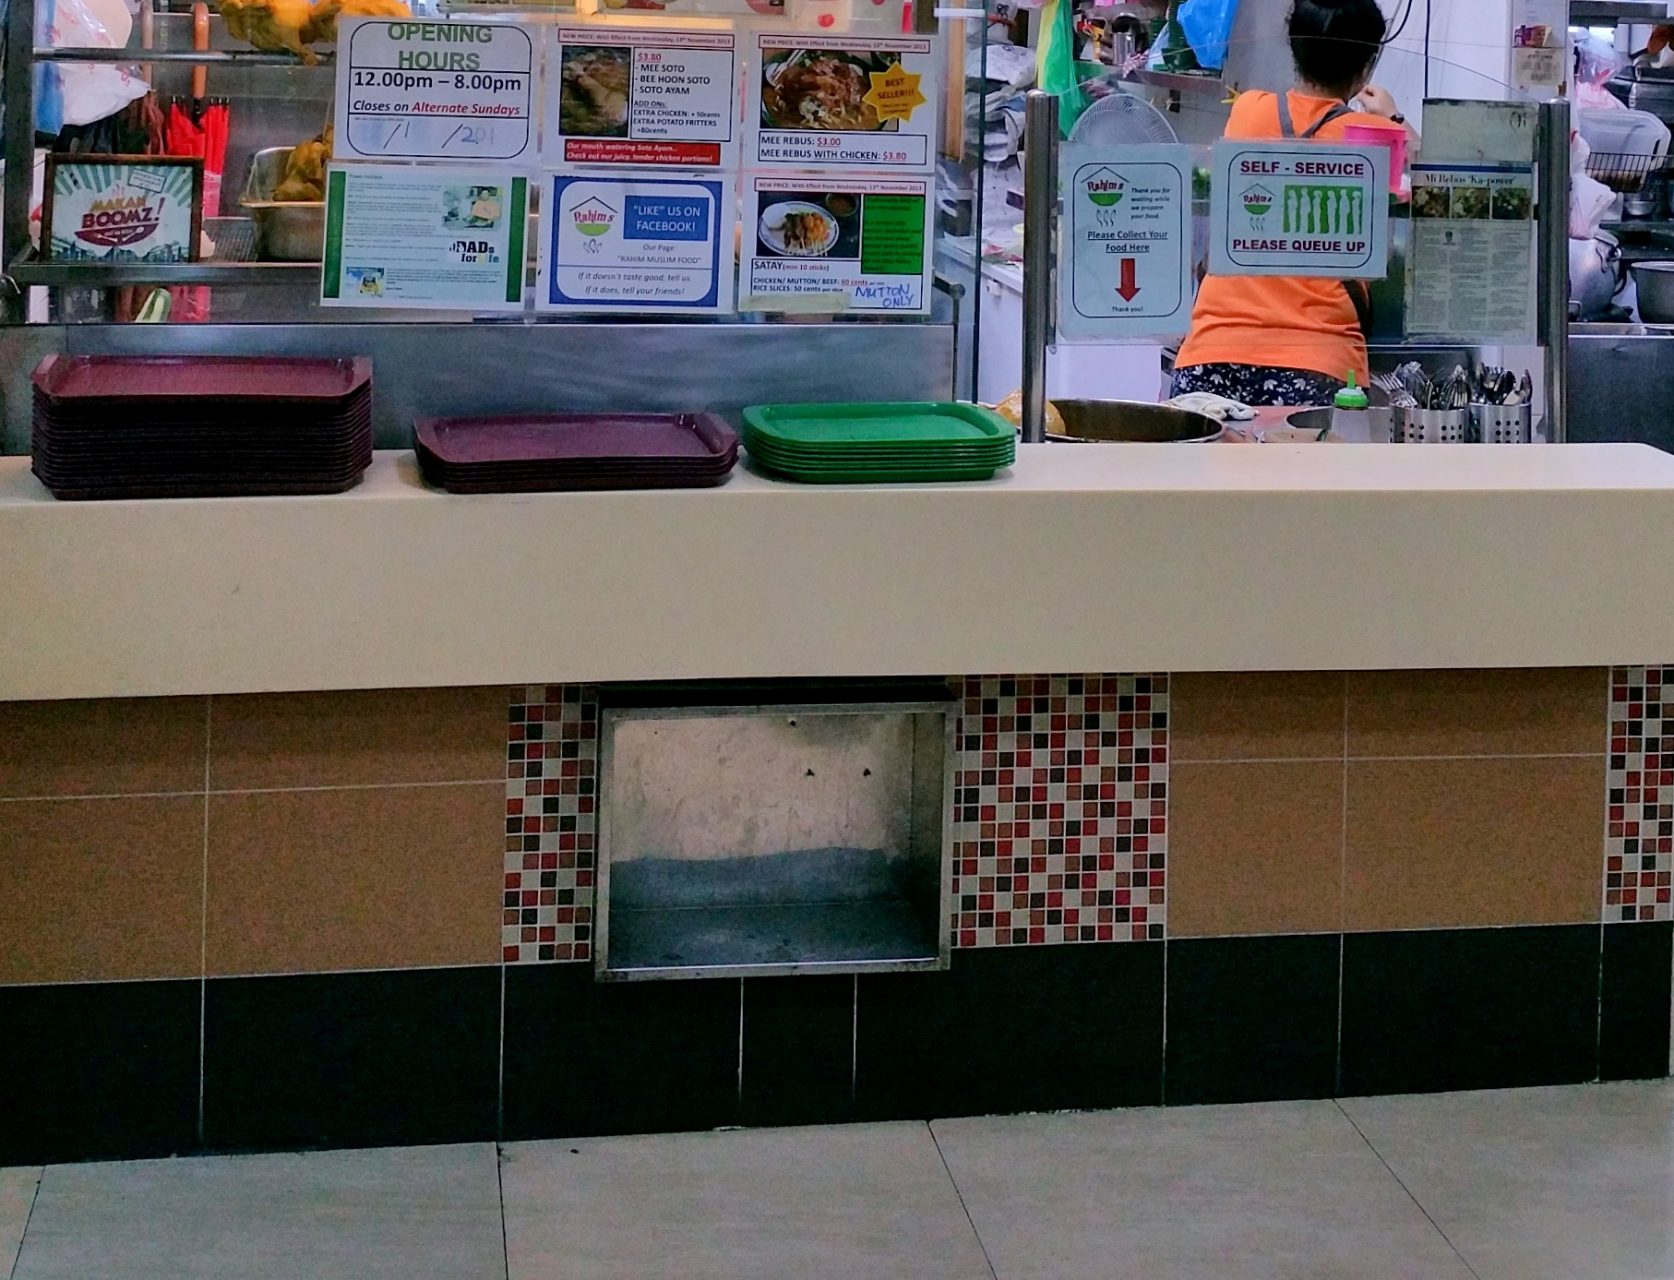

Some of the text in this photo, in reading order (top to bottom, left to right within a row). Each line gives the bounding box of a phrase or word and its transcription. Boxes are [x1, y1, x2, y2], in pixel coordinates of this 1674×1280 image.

[387, 23, 493, 44] OPENING
[399, 50, 481, 71] HOURS
[640, 64, 685, 73] MEE SOTO
[354, 71, 433, 91] 12.00pm
[454, 74, 521, 94] 8.00pm
[640, 75, 656, 83] BEE
[658, 76, 685, 84] HOON
[885, 77, 905, 88] BEST
[639, 86, 690, 95] SOTO AYAM
[353, 100, 520, 116] Closes on Alternate Sundays
[633, 109, 656, 117] EXTRA
[761, 136, 841, 147] MEE REBUS: $3.00
[760, 149, 780, 158] MEE
[782, 149, 812, 158] REBUS
[813, 150, 838, 159] WITH
[1240, 161, 1280, 173] SELF
[1295, 161, 1364, 175] SERVICE
[90, 195, 146, 211] MAKAN
[82, 197, 166, 228] BOOMZ!
[667, 206, 682, 217] US
[684, 207, 701, 217] ON
[1087, 230, 1168, 239] Please Collect Your
[642, 243, 675, 253] Our Page
[1106, 244, 1150, 252] Food Here
[1232, 239, 1365, 252] PLEASE QUEUE UP
[578, 272, 585, 280] If
[585, 272, 592, 280] it
[585, 286, 592, 294] If
[636, 288, 653, 296] your
[855, 284, 910, 299] MUTTON
[882, 294, 915, 308] ONLY
